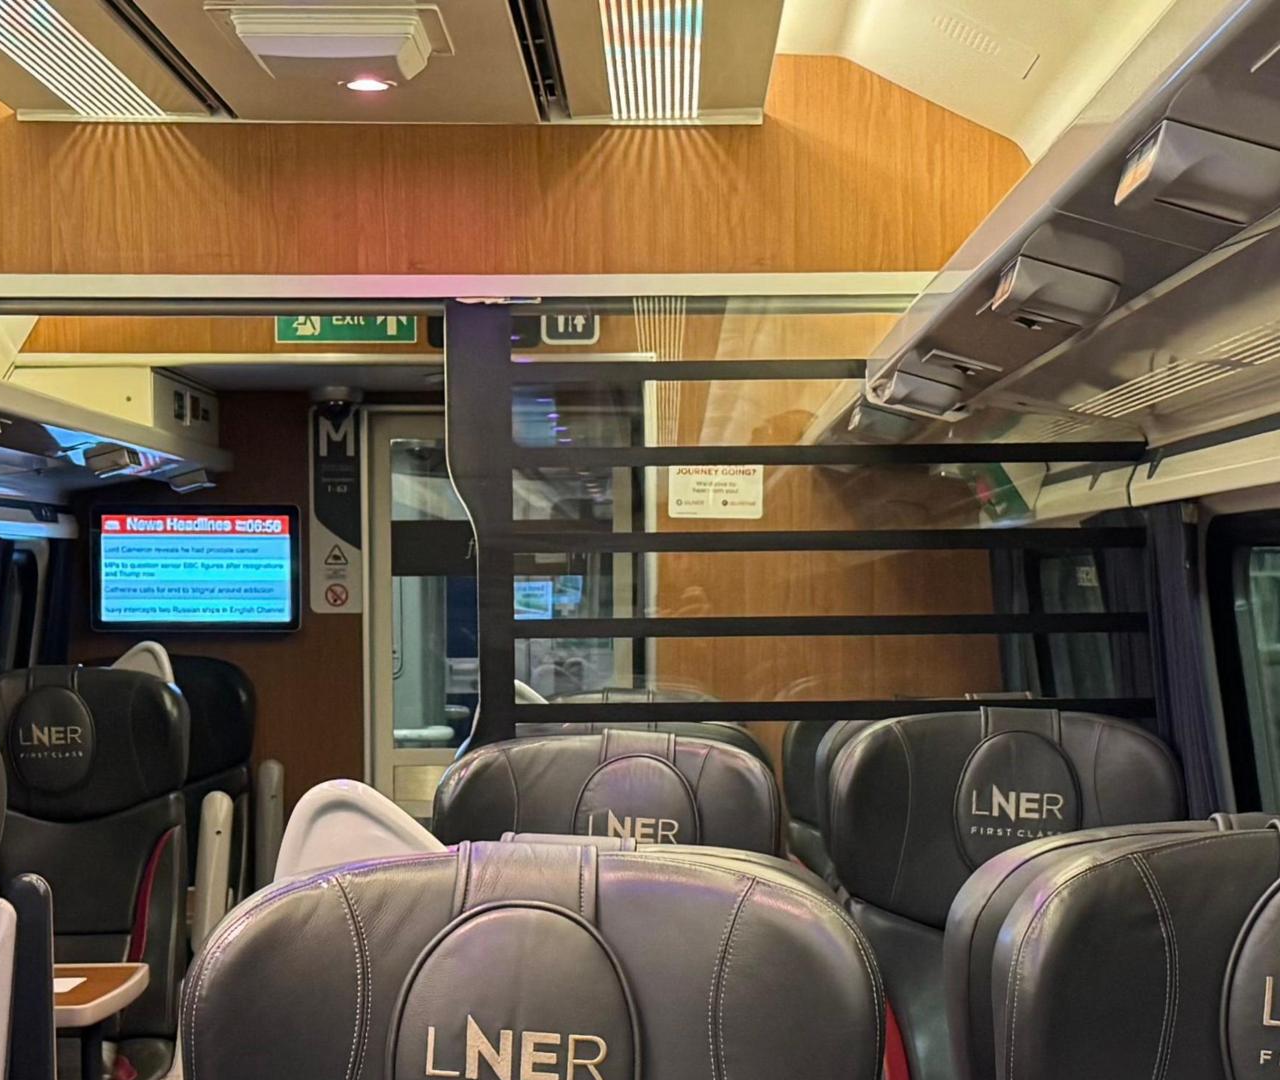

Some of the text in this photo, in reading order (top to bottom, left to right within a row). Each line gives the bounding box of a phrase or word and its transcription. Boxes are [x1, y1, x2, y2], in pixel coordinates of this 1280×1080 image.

[318, 415, 356, 457] M
[676, 467, 757, 476] JOURNEY GOING?
[126, 516, 164, 531] News
[166, 517, 232, 532] Headlines
[105, 586, 138, 594] Catherine
[172, 606, 201, 614] Russian
[18, 722, 83, 747] LNER
[971, 784, 1065, 823] LNER
[970, 825, 1013, 837] FIRST
